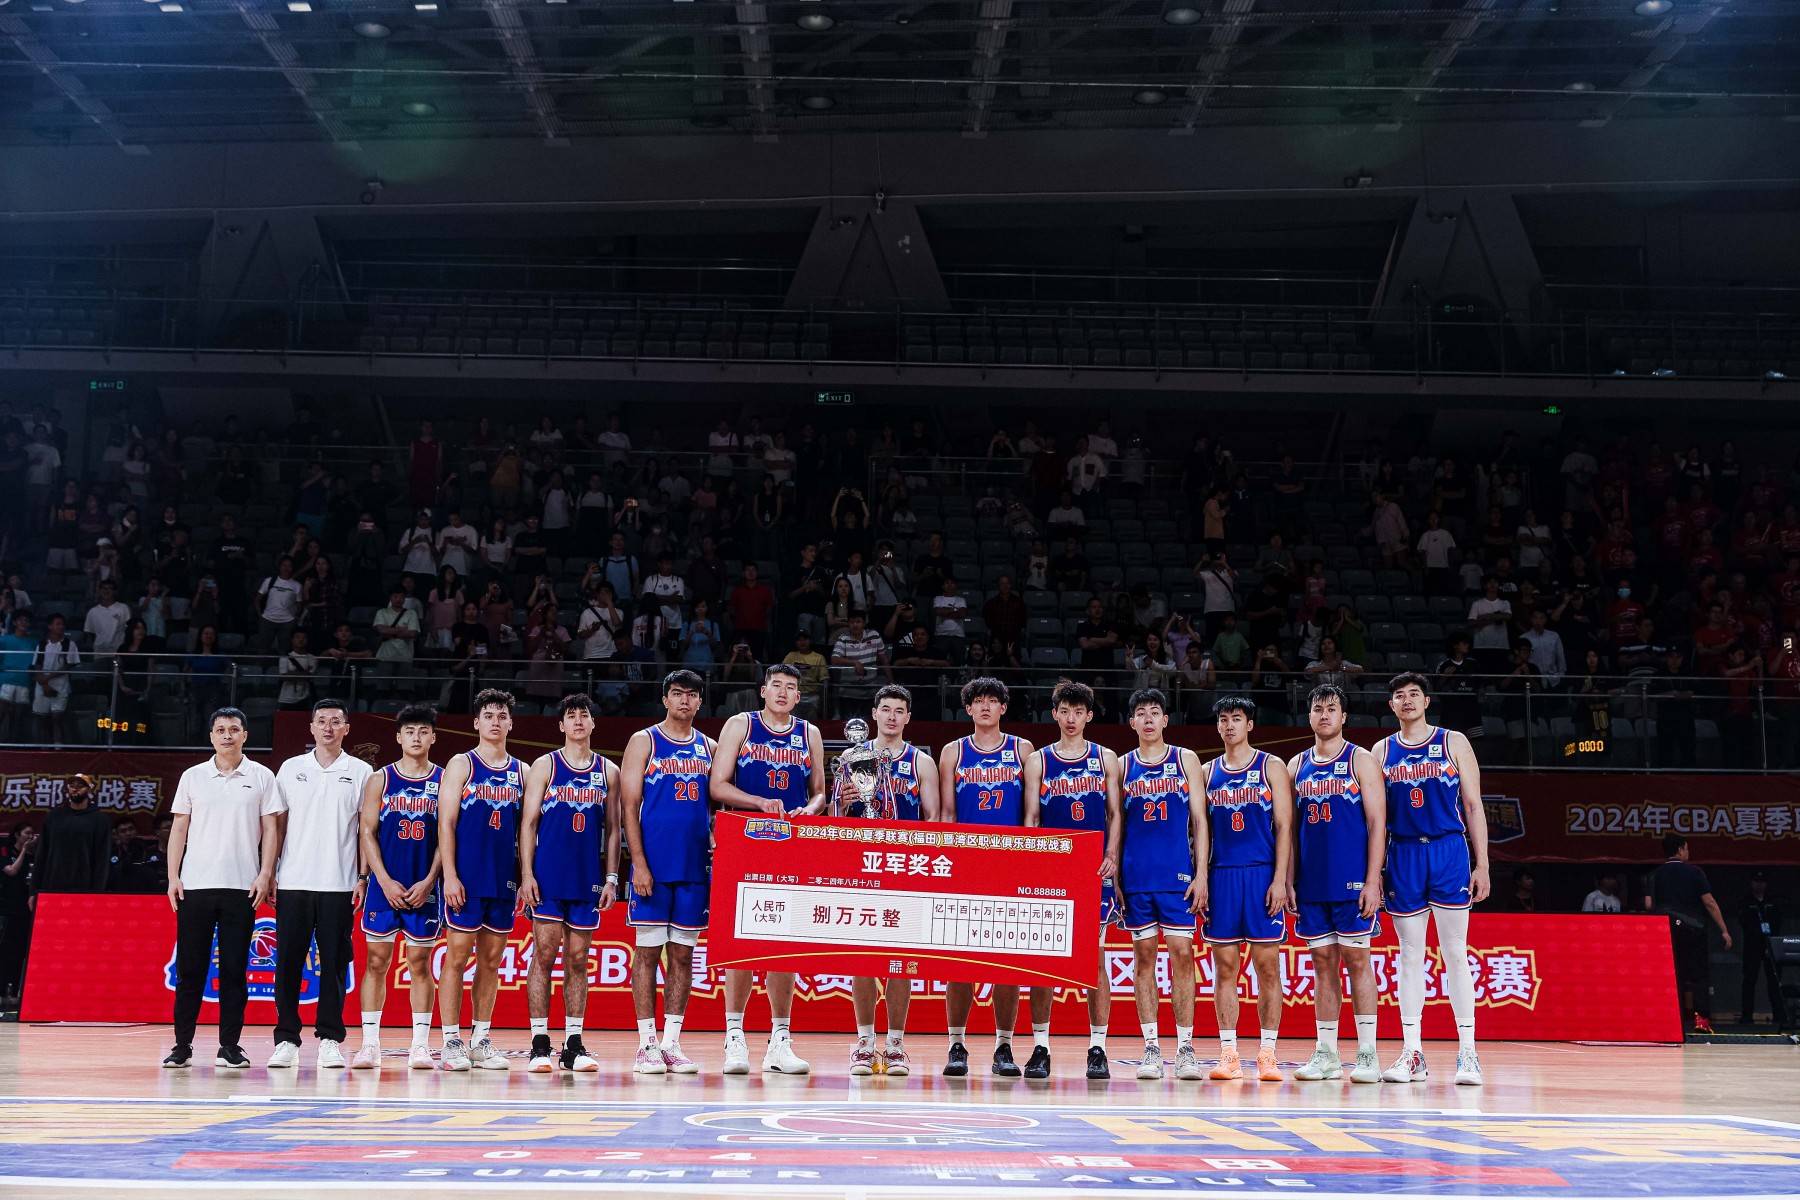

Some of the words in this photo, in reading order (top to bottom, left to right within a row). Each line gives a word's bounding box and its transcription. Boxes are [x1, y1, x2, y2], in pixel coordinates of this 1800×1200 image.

[750, 743, 804, 767] XINJIANG
[659, 758, 709, 776] XINJIANG
[963, 766, 1016, 784] XINJIANG
[1389, 761, 1443, 784] XINJIANG
[766, 769, 790, 791] 13
[1049, 776, 1102, 797] XINJIANG
[1129, 777, 1180, 798] XINJIANG
[2, 778, 157, 811] 乐部战赛
[475, 783, 520, 804] XINJIANG
[556, 785, 603, 805] XINJIANG
[674, 781, 700, 801] 26
[978, 789, 1004, 811] 27
[1211, 786, 1261, 807] XINJIANG
[1410, 787, 1424, 808] 9
[388, 795, 437, 815] XINJIANG
[1070, 801, 1085, 822] 6
[1143, 801, 1168, 822] 21
[1307, 802, 1333, 824] 34
[398, 820, 425, 840] 36
[488, 810, 502, 831] 4
[572, 812, 586, 833] 0
[1231, 811, 1245, 832] 8
[1569, 804, 1800, 837] 2024年CBA夏季
[861, 851, 954, 878] 亚军奖金
[807, 876, 881, 888] 二零二四年八月十八日
[1017, 886, 1067, 897] NO.888888
[751, 900, 786, 913] 人民币
[812, 904, 901, 928] 捌万元整
[400, 1168, 823, 1178] SUMMER
[934, 1171, 1317, 1187] LEAGUE
